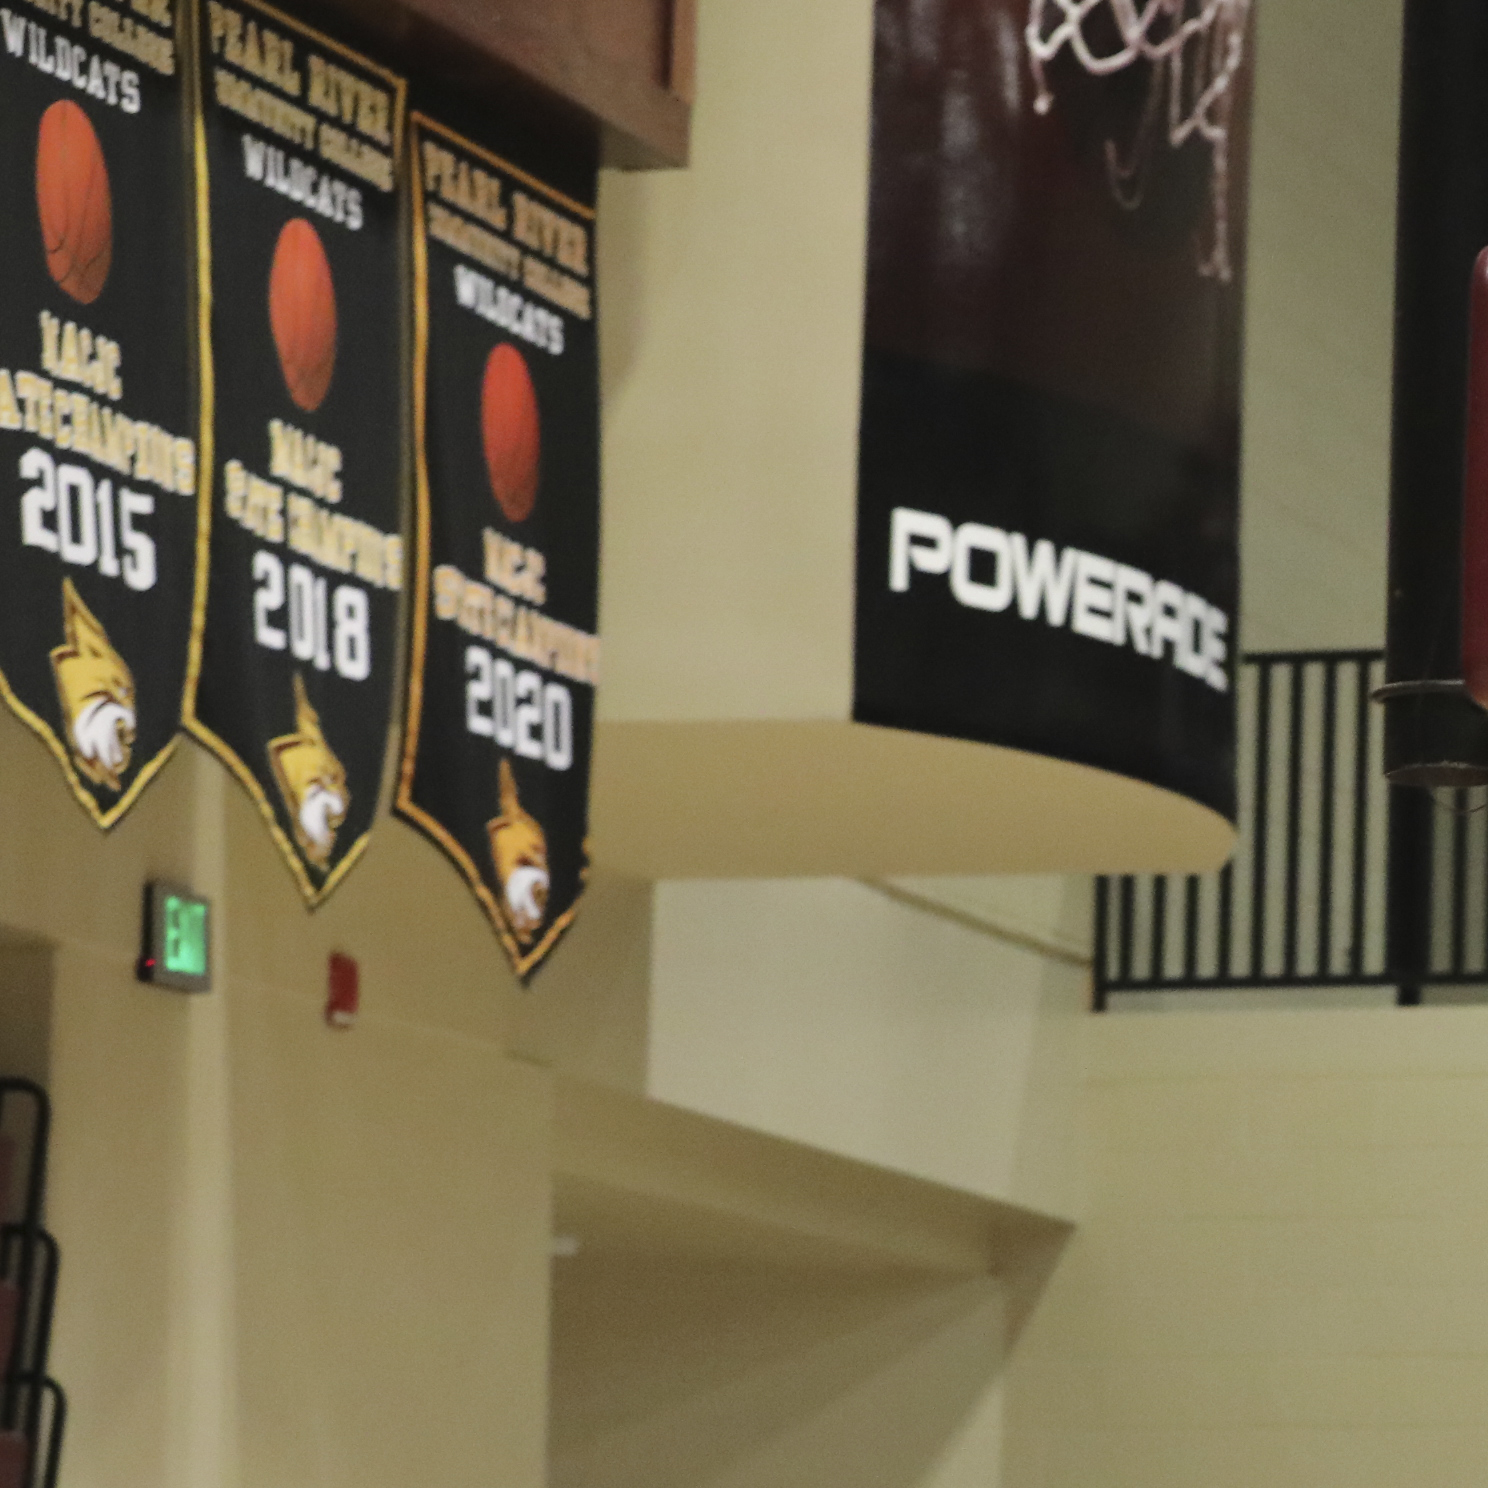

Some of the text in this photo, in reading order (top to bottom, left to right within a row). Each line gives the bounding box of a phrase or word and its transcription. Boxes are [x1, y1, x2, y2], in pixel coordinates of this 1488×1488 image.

[0, 7, 141, 114] WILDCATS
[241, 133, 363, 231] WILDCATS
[19, 446, 157, 592] 2015
[252, 550, 371, 682] 2018
[888, 506, 1230, 693] POWERADE
[465, 645, 574, 772] 2020
